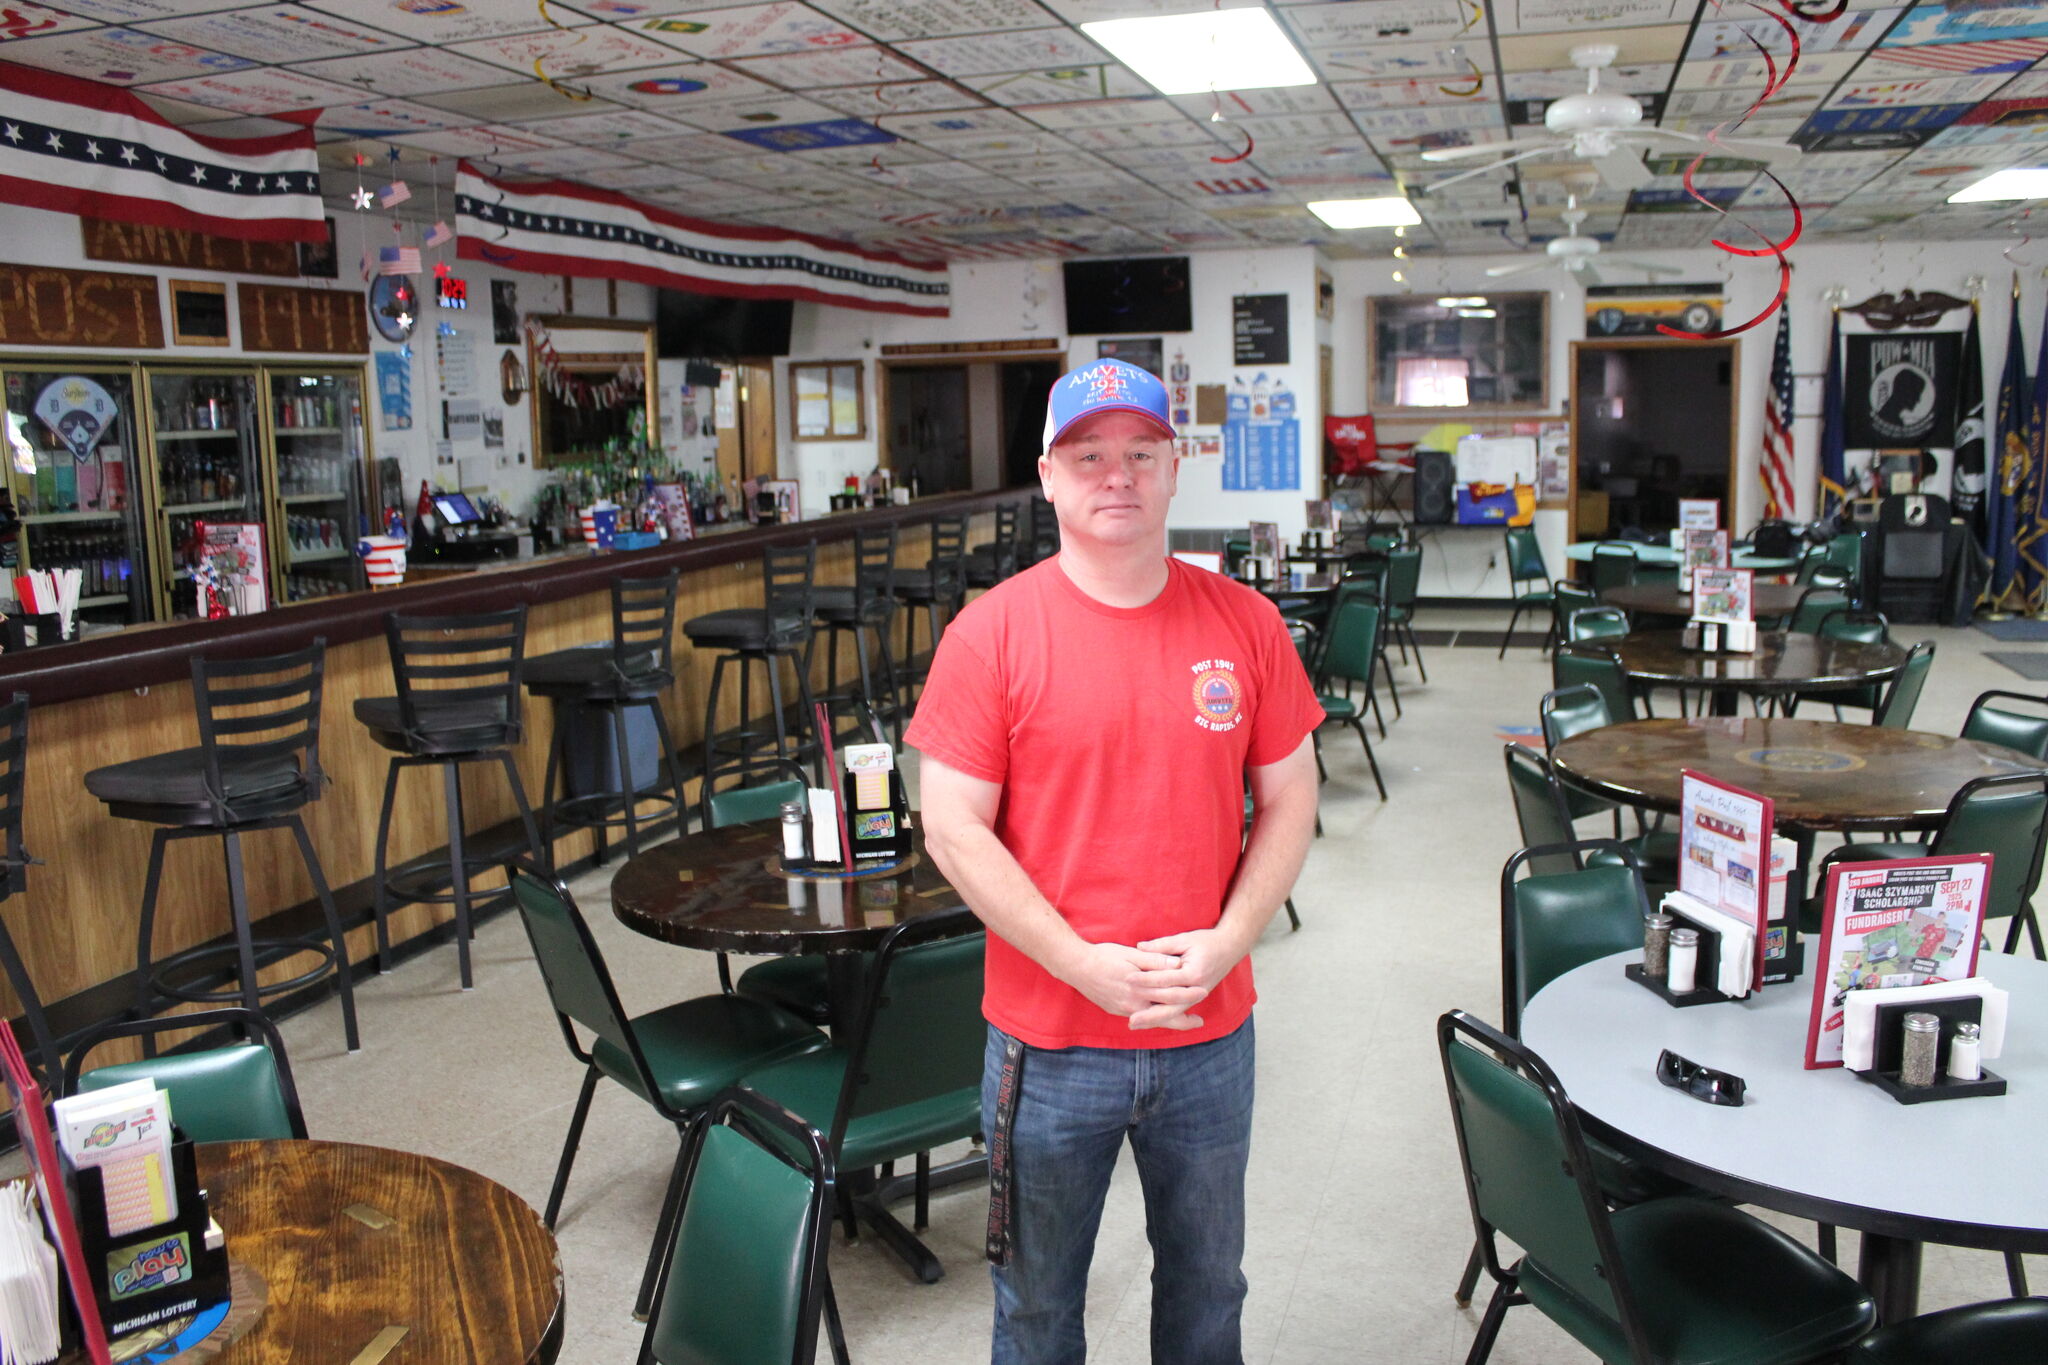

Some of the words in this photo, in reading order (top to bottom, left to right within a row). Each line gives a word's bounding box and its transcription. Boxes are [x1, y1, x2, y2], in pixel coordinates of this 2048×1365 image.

[1068, 365, 1149, 389] AMVETS
[1090, 380, 1128, 391] 1941
[1191, 660, 1211, 674] POST
[1215, 660, 1235, 671] 1941
[1194, 715, 1209, 728] BIG
[1857, 888, 1882, 899] ISAAC
[1885, 884, 1934, 898] SZYMANSKI
[1940, 880, 1960, 894] SEPT
[1962, 878, 1973, 890] 27
[1864, 896, 1923, 909] SCHOLARSHIP
[1946, 901, 1963, 911] 2PM
[1847, 910, 1904, 930] FUNDRAISER
[998, 1064, 1014, 1110] USMC
[992, 1132, 1004, 1174] USMC
[989, 1197, 1003, 1238] USMC
[114, 1247, 184, 1293] play
[113, 1310, 159, 1334] MICHIGAN
[161, 1299, 197, 1318] LOTTERY
